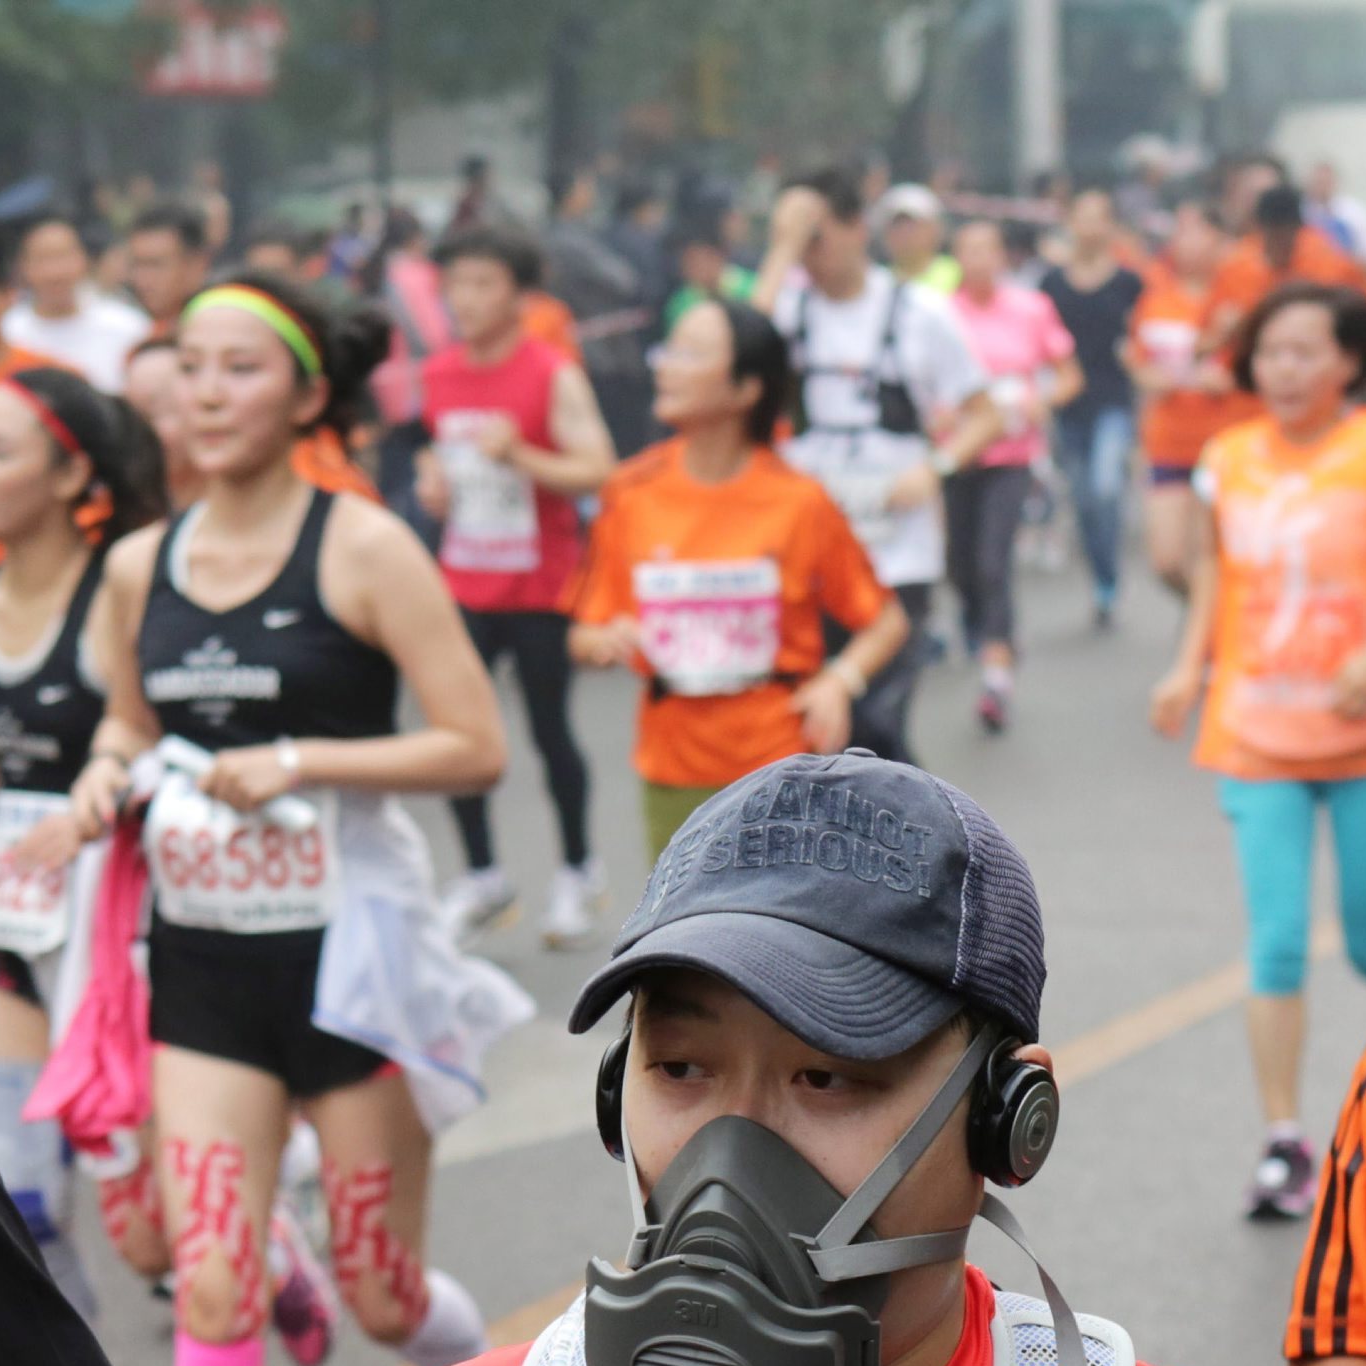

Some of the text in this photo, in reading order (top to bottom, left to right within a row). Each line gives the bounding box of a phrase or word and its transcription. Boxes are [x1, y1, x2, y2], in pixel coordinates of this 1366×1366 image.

[740, 779, 933, 857] CANNOT
[159, 824, 326, 892] 68589
[701, 825, 933, 898] SERIOUS!
[675, 1298, 718, 1329] 3M
